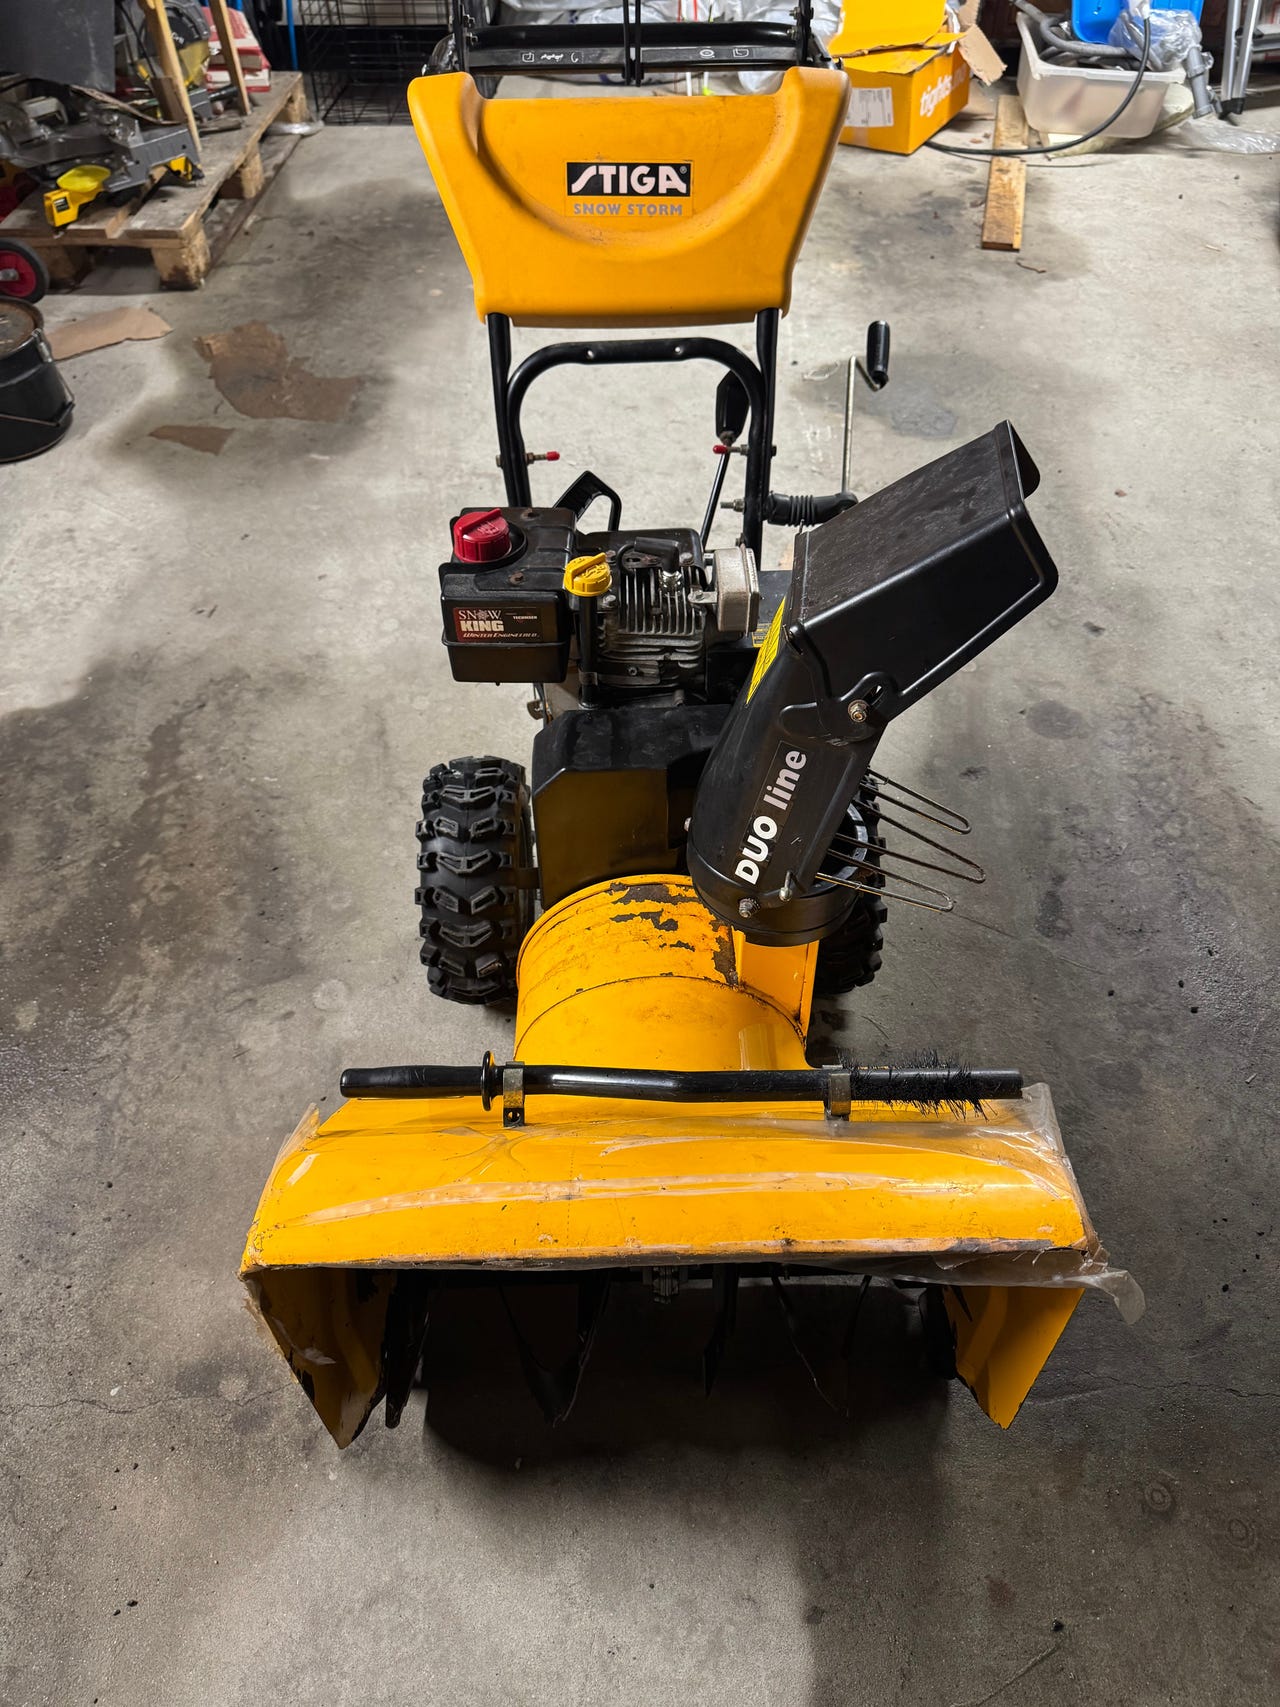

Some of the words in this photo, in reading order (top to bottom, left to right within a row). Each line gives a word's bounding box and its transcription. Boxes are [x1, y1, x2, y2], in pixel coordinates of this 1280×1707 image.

[571, 165, 687, 194] STIGA
[573, 203, 621, 215] SNOW
[627, 204, 683, 216] STORM
[460, 620, 504, 632] KING
[734, 815, 778, 885] DUO
[763, 750, 807, 811] line
